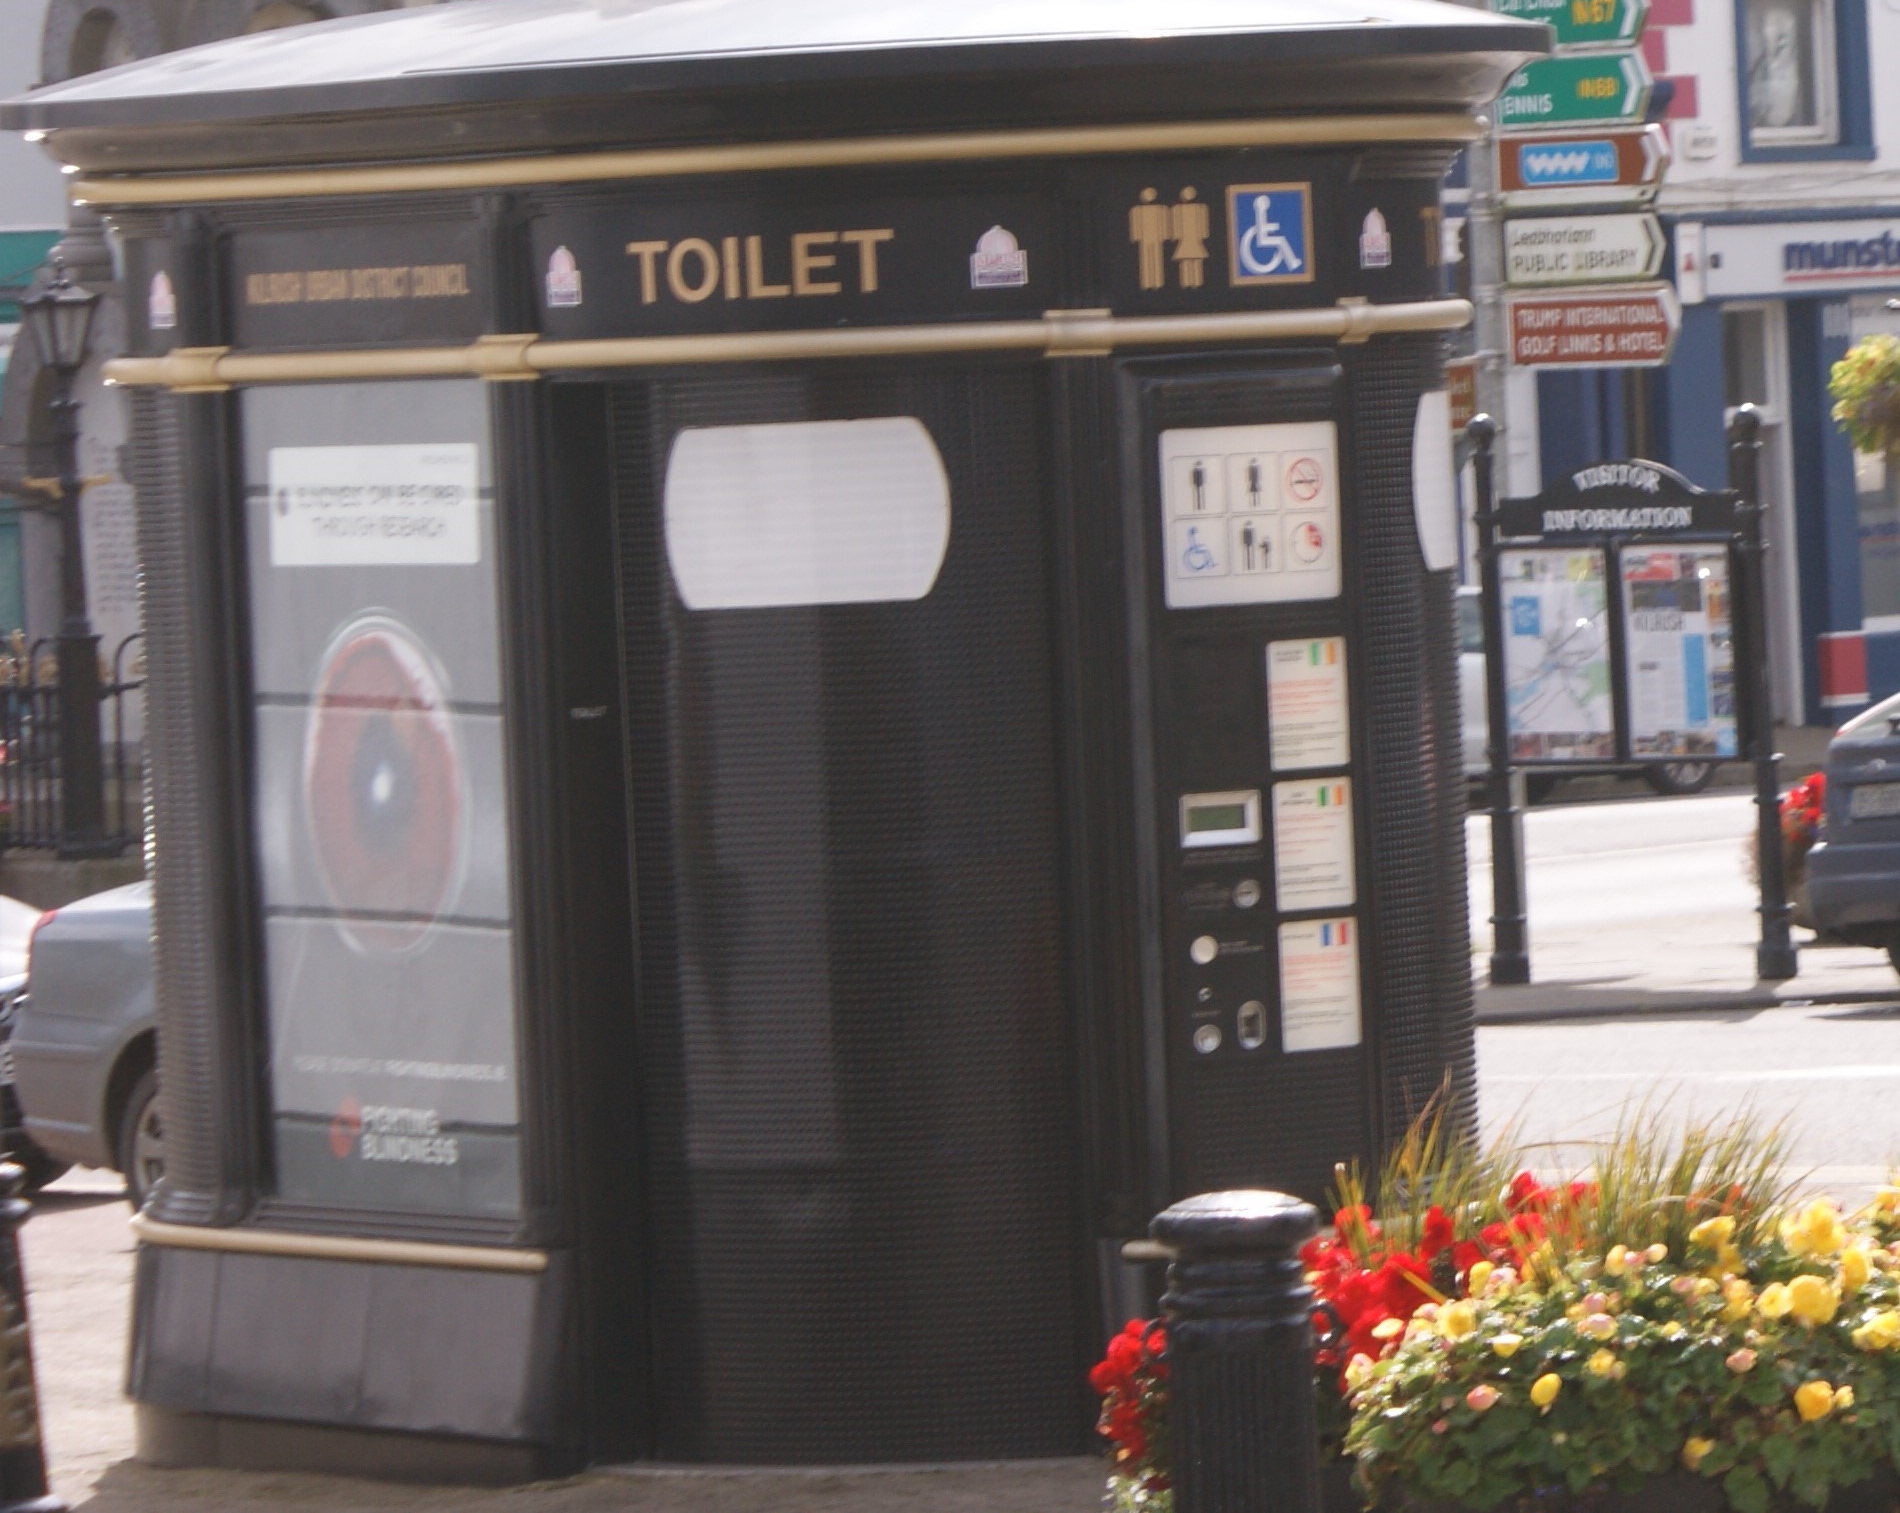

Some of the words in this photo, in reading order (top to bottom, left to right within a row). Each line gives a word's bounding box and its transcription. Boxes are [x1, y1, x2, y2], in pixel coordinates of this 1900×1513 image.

[1504, 93, 1553, 115] ENNIS
[625, 228, 895, 305] TOILET
[1513, 253, 1569, 274] PUBLIC
[1575, 248, 1637, 270] LIBRARY
[1517, 308, 1562, 328] TRUMP
[1565, 304, 1665, 326] INTERNATIONAL
[1518, 335, 1557, 356] GOLF
[1559, 333, 1601, 355] LINKS
[1604, 333, 1616, 353] &
[1618, 330, 1666, 351] HOTEL
[1572, 464, 1661, 494] VISITOR
[1542, 506, 1693, 532] INFORMATION
[360, 1134, 460, 1167] BLINDNESS
